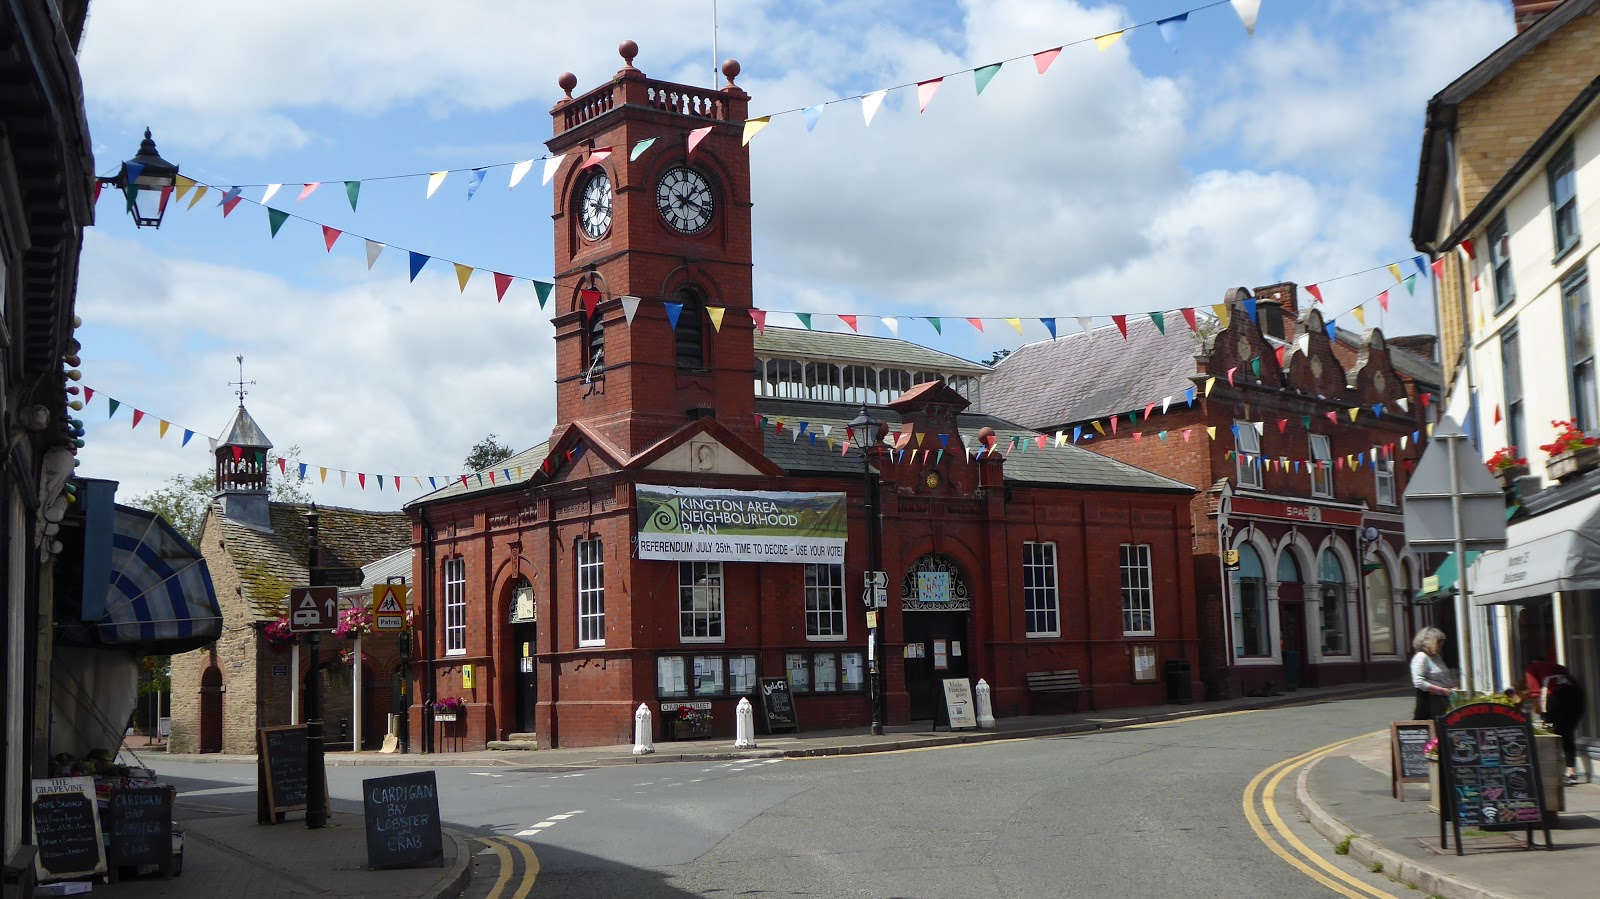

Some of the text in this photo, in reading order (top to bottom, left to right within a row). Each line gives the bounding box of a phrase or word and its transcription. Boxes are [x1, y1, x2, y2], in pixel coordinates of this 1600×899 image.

[680, 497, 779, 513] KINGTON AREA
[681, 511, 798, 526] NEIGHBOURHOOD
[682, 523, 718, 535] PLAN
[640, 540, 693, 553] REFERENDUM
[696, 542, 713, 553] JULY
[715, 542, 733, 555] 25th,
[735, 543, 751, 554] TIME
[753, 543, 763, 554] TO
[765, 544, 788, 555] DECIDE
[795, 545, 808, 556] USE
[810, 545, 825, 556] YOUR
[827, 546, 843, 556] VOTE!
[689, 702, 710, 710] STREET
[35, 784, 85, 793] GRAPEVINE
[51, 778, 69, 786] THE
[115, 794, 162, 807] CARDIGAN
[373, 784, 433, 804] CARDIGAN
[125, 807, 144, 819] BAY
[387, 803, 407, 816] BAY
[376, 814, 429, 831] LOBSTER
[397, 827, 411, 836] and
[387, 835, 422, 851] CRAB
